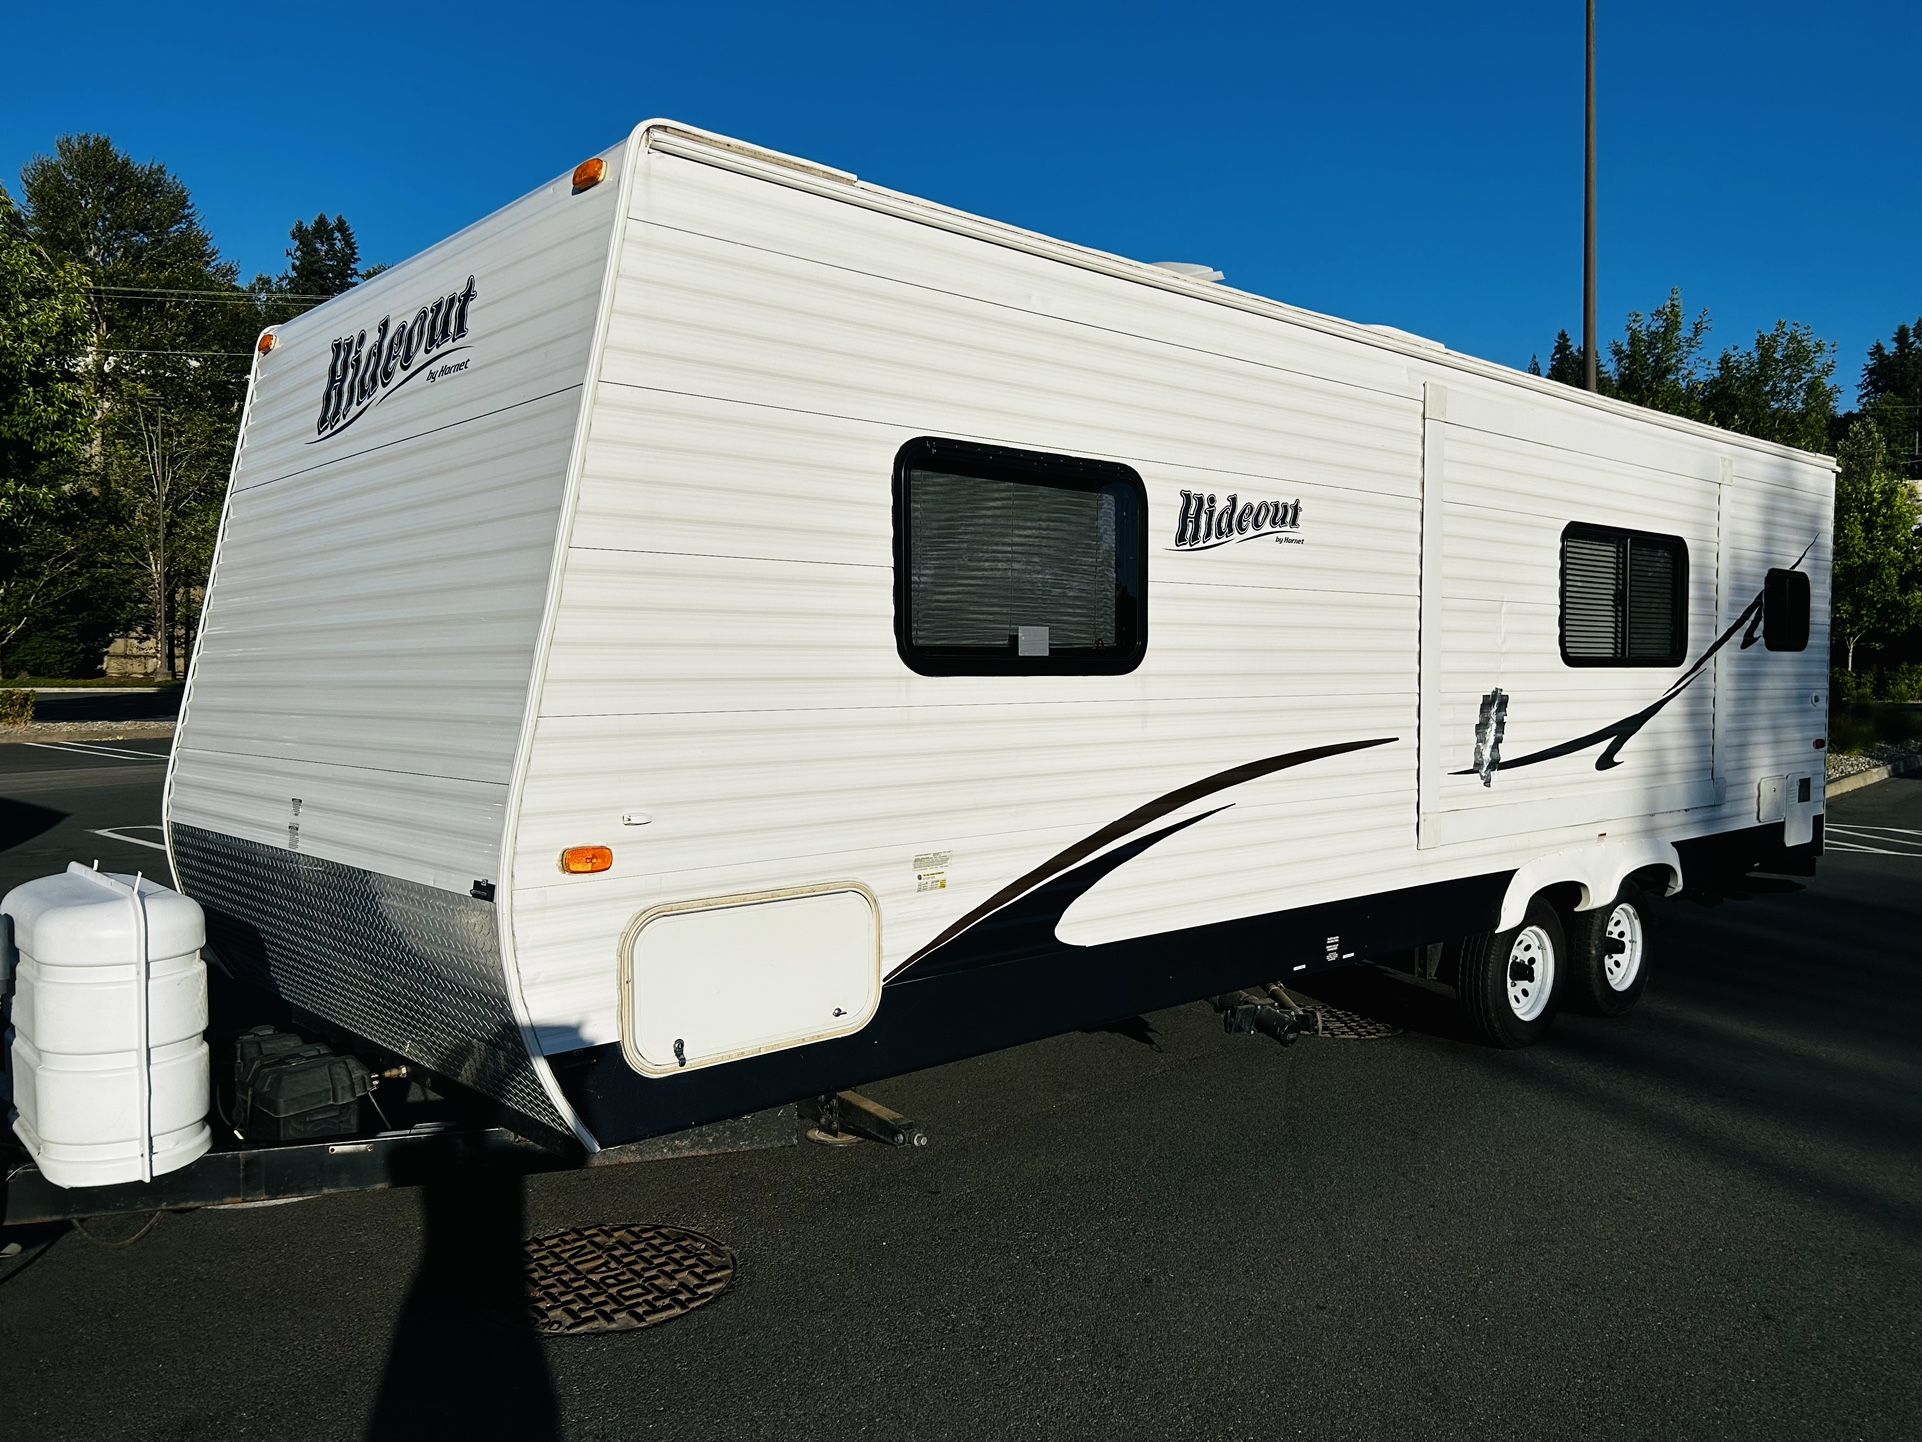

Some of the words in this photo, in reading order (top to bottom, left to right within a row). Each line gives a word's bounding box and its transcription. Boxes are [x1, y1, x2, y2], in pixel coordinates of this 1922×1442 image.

[317, 275, 477, 435] Hideout
[426, 370, 439, 383] by
[438, 358, 470, 378] Hornet
[1175, 489, 1303, 547] Hideout
[1275, 536, 1283, 545] by
[1283, 536, 1305, 545] Hornet
[559, 1244, 651, 1300] DRAIN
